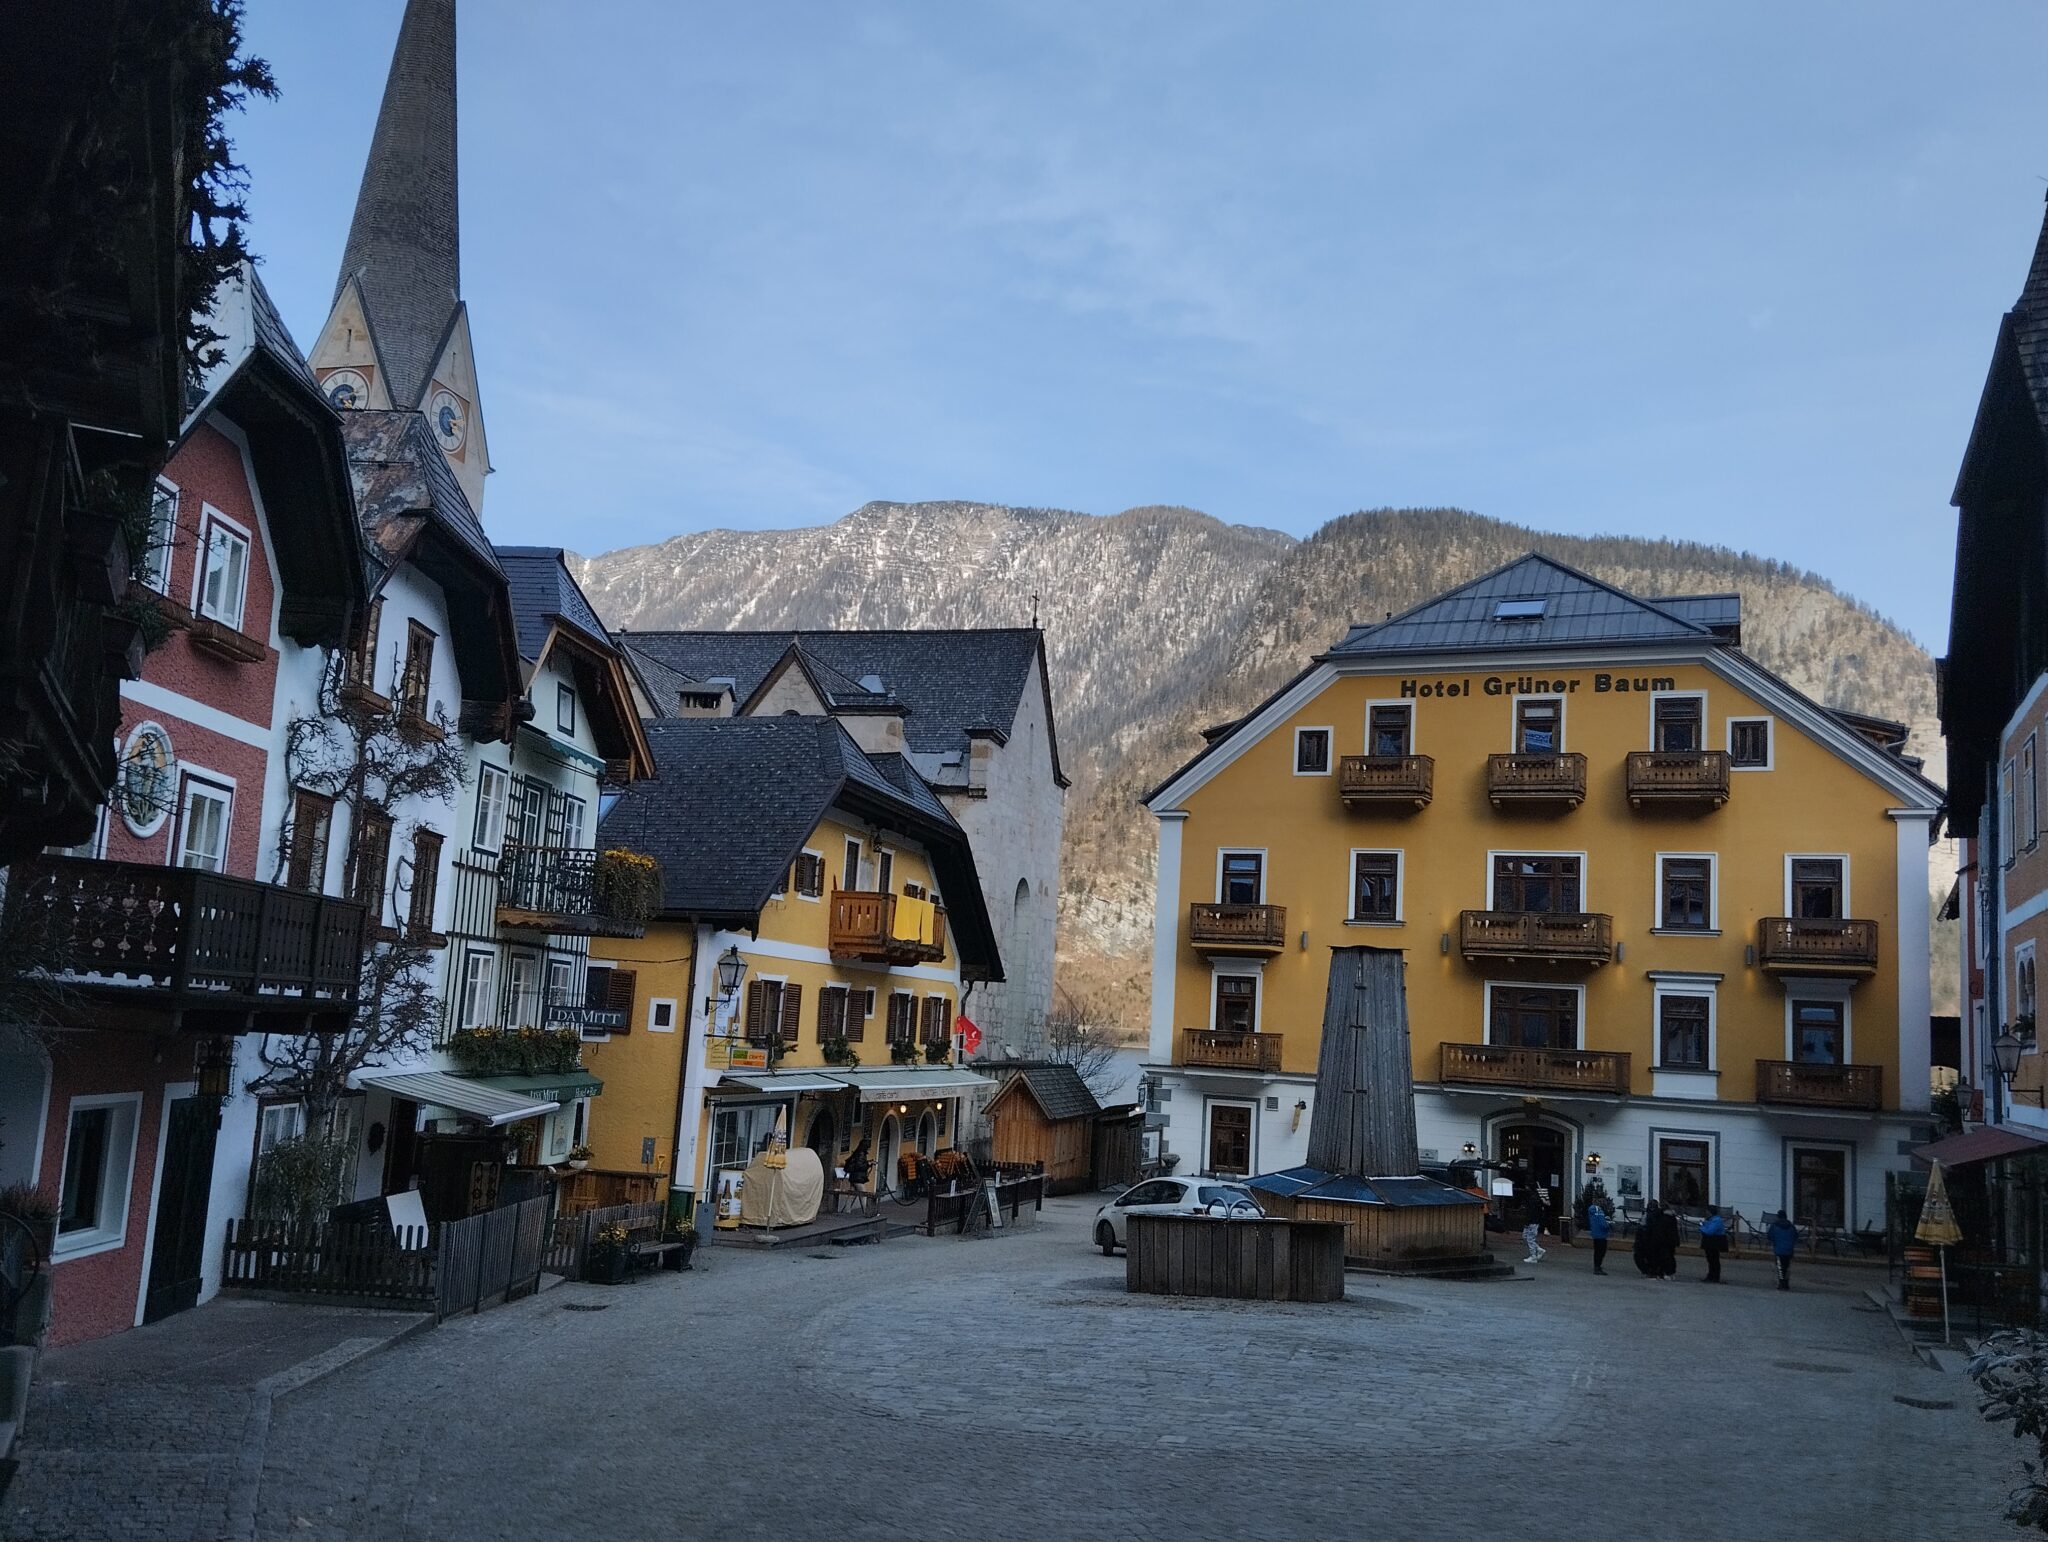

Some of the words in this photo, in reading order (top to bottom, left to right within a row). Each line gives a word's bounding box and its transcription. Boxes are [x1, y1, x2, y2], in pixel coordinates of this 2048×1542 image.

[1401, 680, 1470, 698] Hotel
[1483, 676, 1581, 696] Grüner
[1594, 673, 1676, 693] Baum
[580, 1009, 621, 1025] MITT
